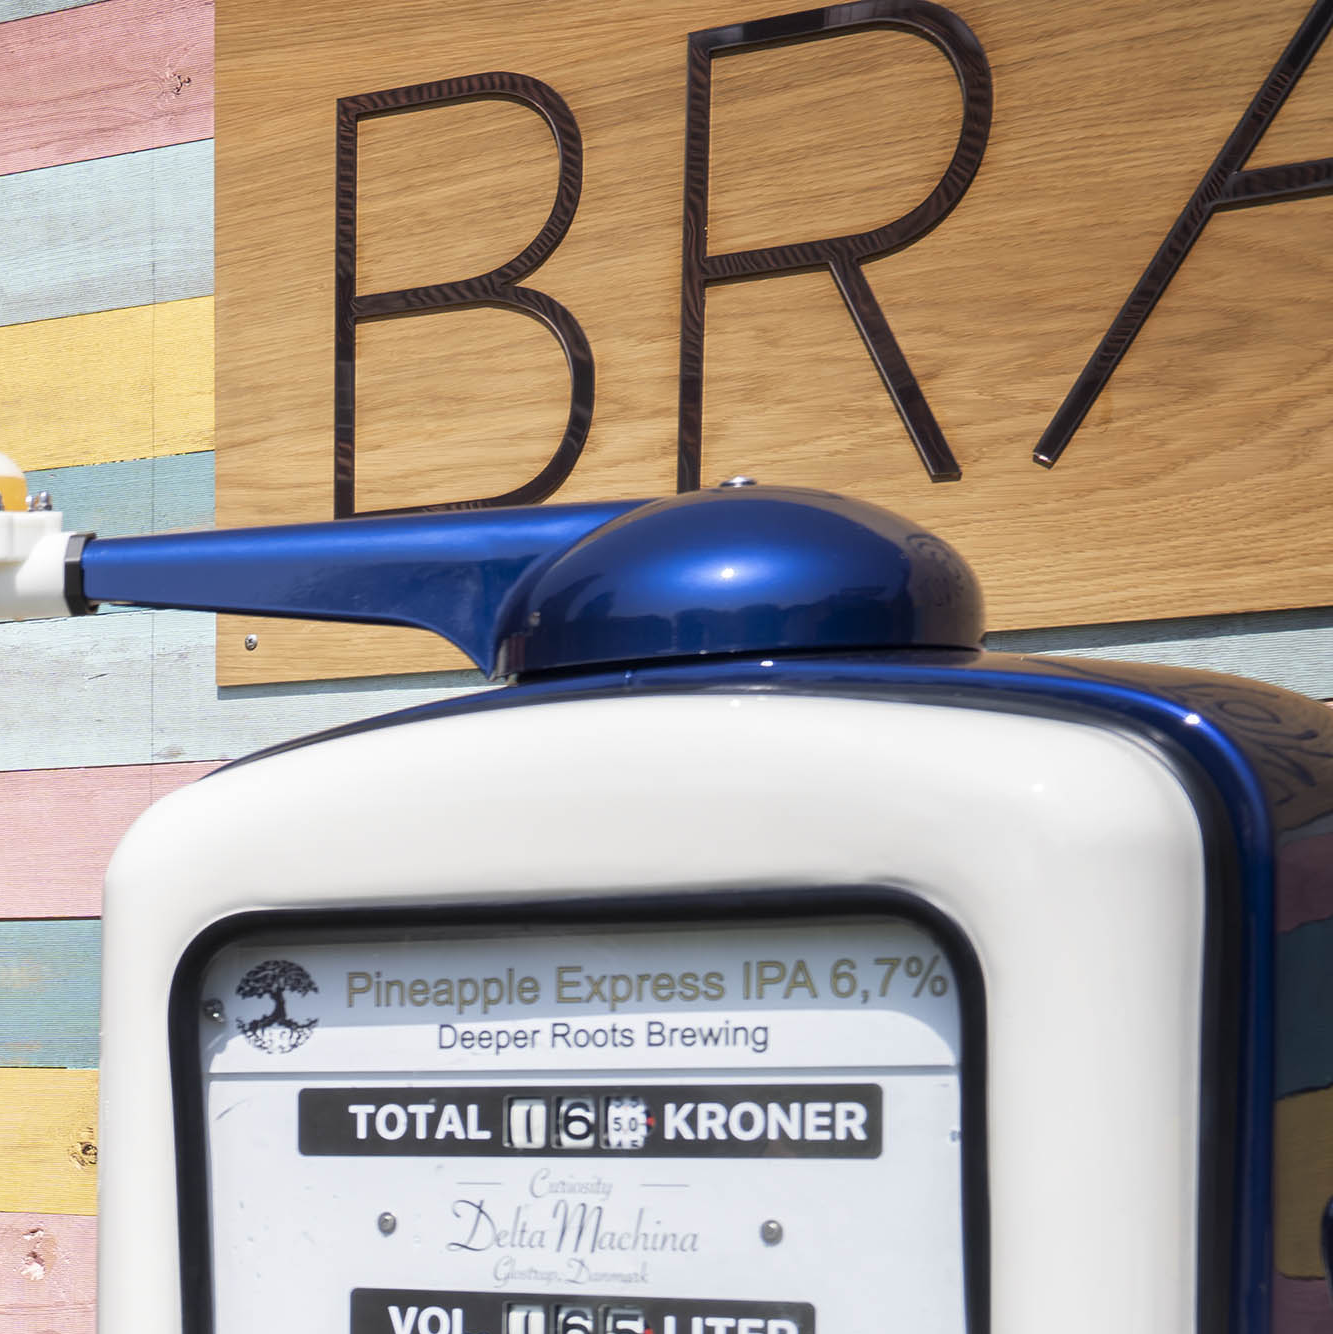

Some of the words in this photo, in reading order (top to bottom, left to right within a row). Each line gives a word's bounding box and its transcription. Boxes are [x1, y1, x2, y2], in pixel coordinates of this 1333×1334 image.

[346, 967, 540, 1015] Pineapple
[555, 965, 725, 1011] Express
[743, 960, 817, 1000] IPA
[831, 955, 948, 1004] 6,7%
[439, 1023, 540, 1056] Deeper
[551, 1021, 634, 1048] Roots
[647, 1020, 769, 1054] Brewing
[348, 1103, 492, 1141] TOTAL
[664, 1101, 868, 1141] KRONER
[446, 1199, 547, 1252] Delta
[552, 1199, 699, 1254] Machina
